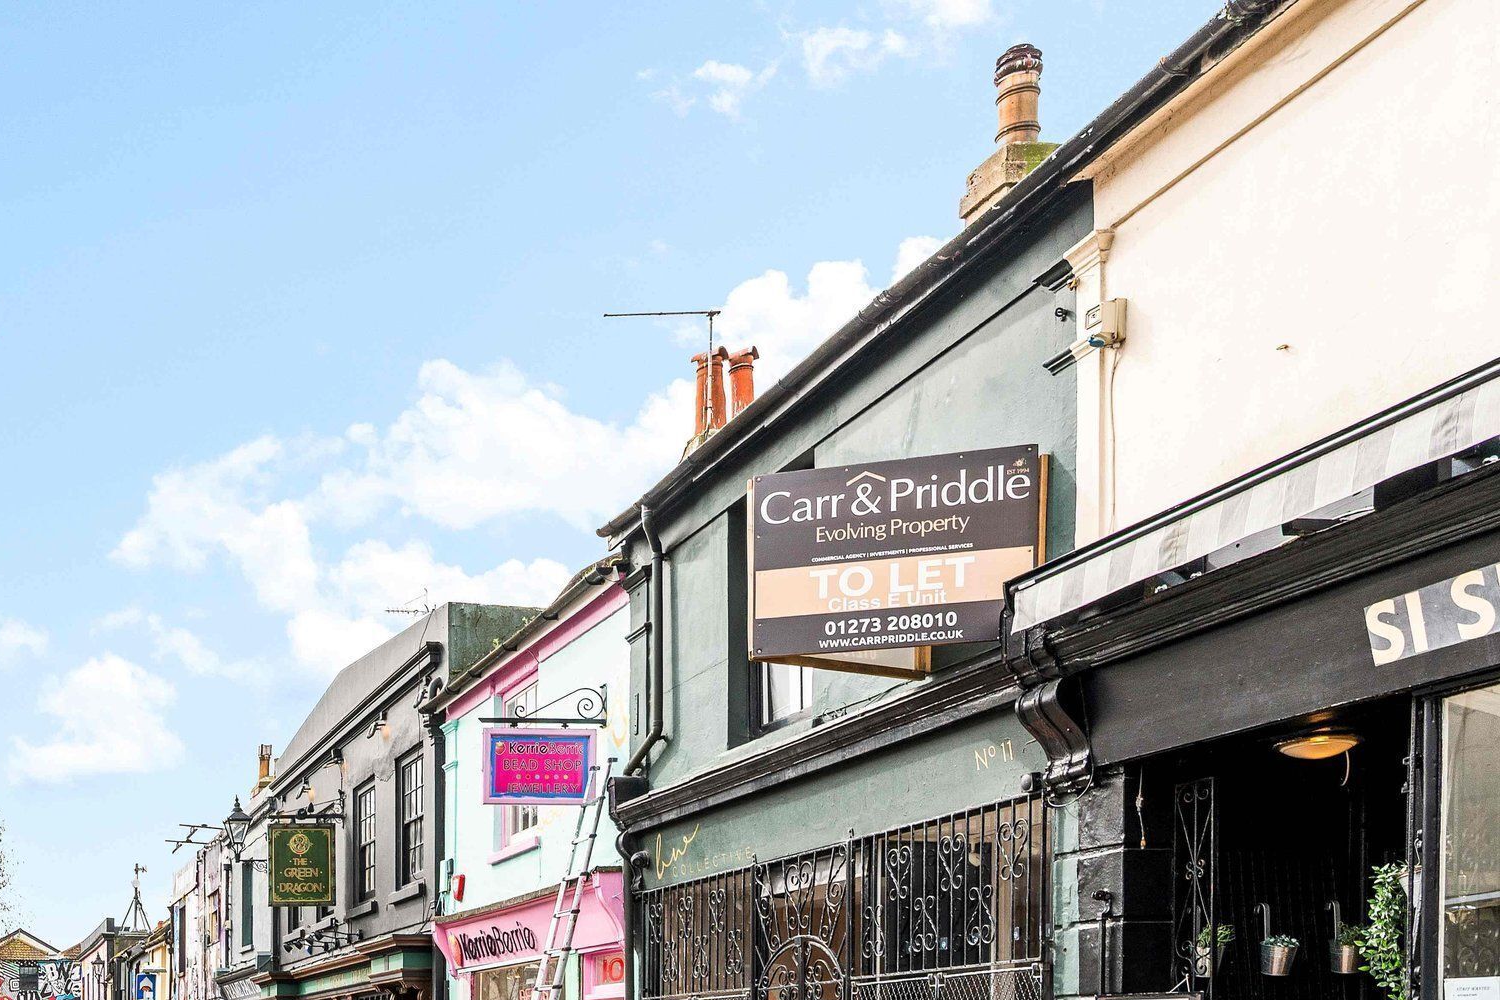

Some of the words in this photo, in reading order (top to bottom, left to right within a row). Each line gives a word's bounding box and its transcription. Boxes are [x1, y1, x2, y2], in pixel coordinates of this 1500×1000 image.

[760, 491, 846, 525] Carr
[850, 482, 882, 517] &
[890, 464, 1031, 512] Priddle
[816, 522, 886, 543] Evolving
[890, 515, 970, 537] Property
[811, 555, 845, 563] COMMERCIAL
[870, 549, 905, 557] INVESTMENTS
[909, 545, 948, 553] PROFESSIONAL
[809, 565, 873, 600] TO
[890, 556, 975, 593] LET
[828, 597, 880, 612] Class
[888, 592, 900, 608] E
[908, 589, 946, 605] Unit
[824, 617, 881, 636] 01273
[887, 611, 958, 631] 208010
[1365, 590, 1429, 667] SI
[1450, 563, 1500, 640] S
[818, 630, 963, 649] WWW.CARRPRIDDLE.CO.UK
[503, 759, 538, 771] BEAD
[544, 759, 582, 771] SHOP
[507, 783, 579, 794] JEWELLERY
[292, 857, 308, 866] THE
[672, 846, 752, 878] COLLECTIVE
[284, 867, 319, 881] GREEN
[279, 882, 323, 896] DRAGON
[459, 921, 536, 961] KerrieBerrie
